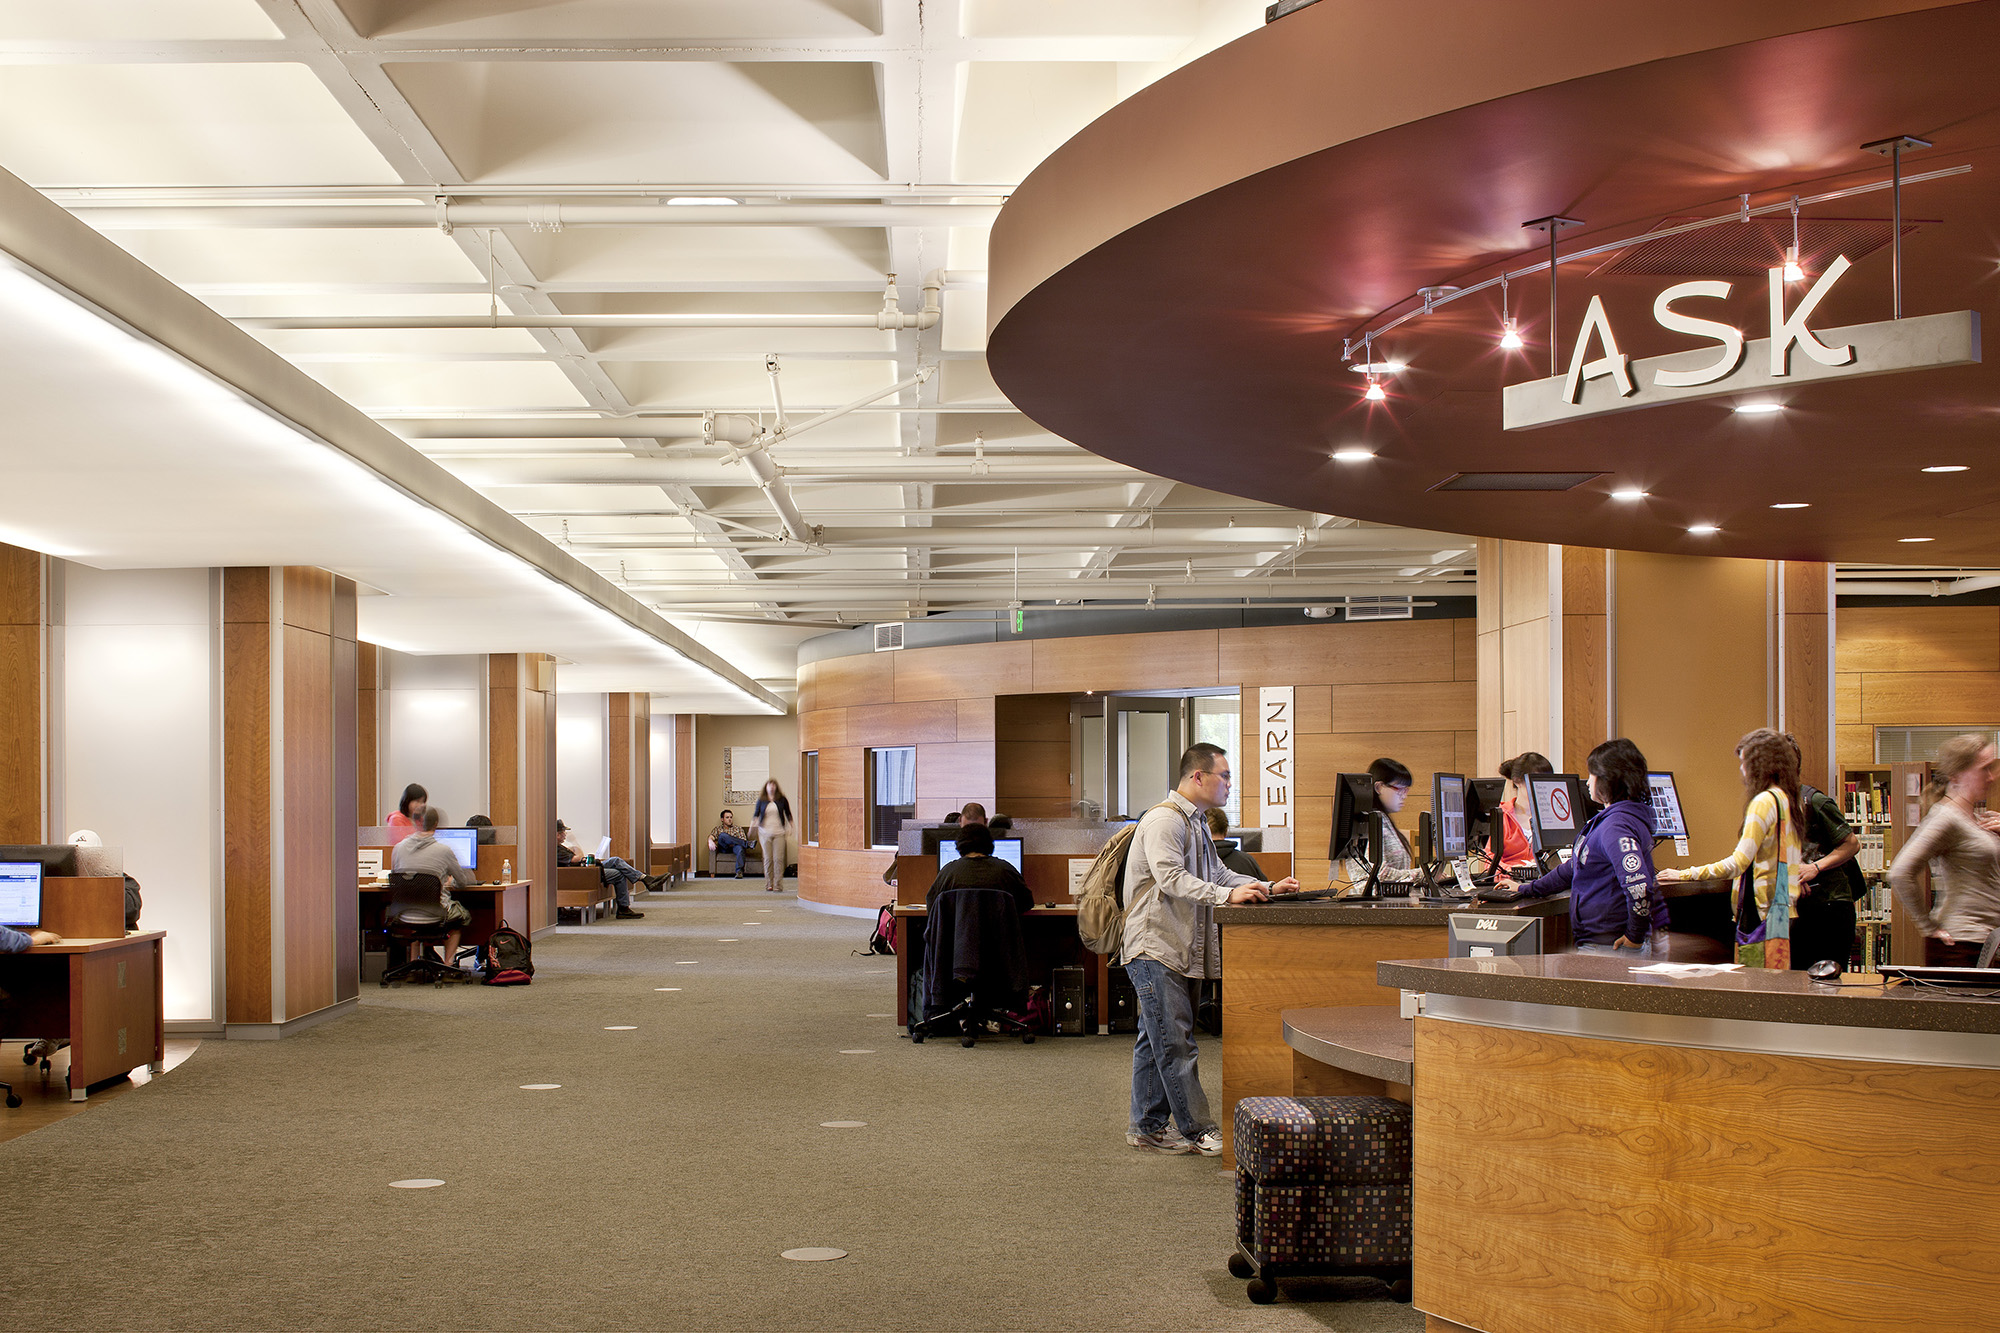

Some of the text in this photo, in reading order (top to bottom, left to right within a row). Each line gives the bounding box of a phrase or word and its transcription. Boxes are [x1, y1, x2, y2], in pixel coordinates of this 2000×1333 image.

[1562, 254, 1854, 405] ASK
[1266, 702, 1288, 828] LEARN
[1475, 919, 1499, 931] DELL
[1627, 882, 1647, 900] W
